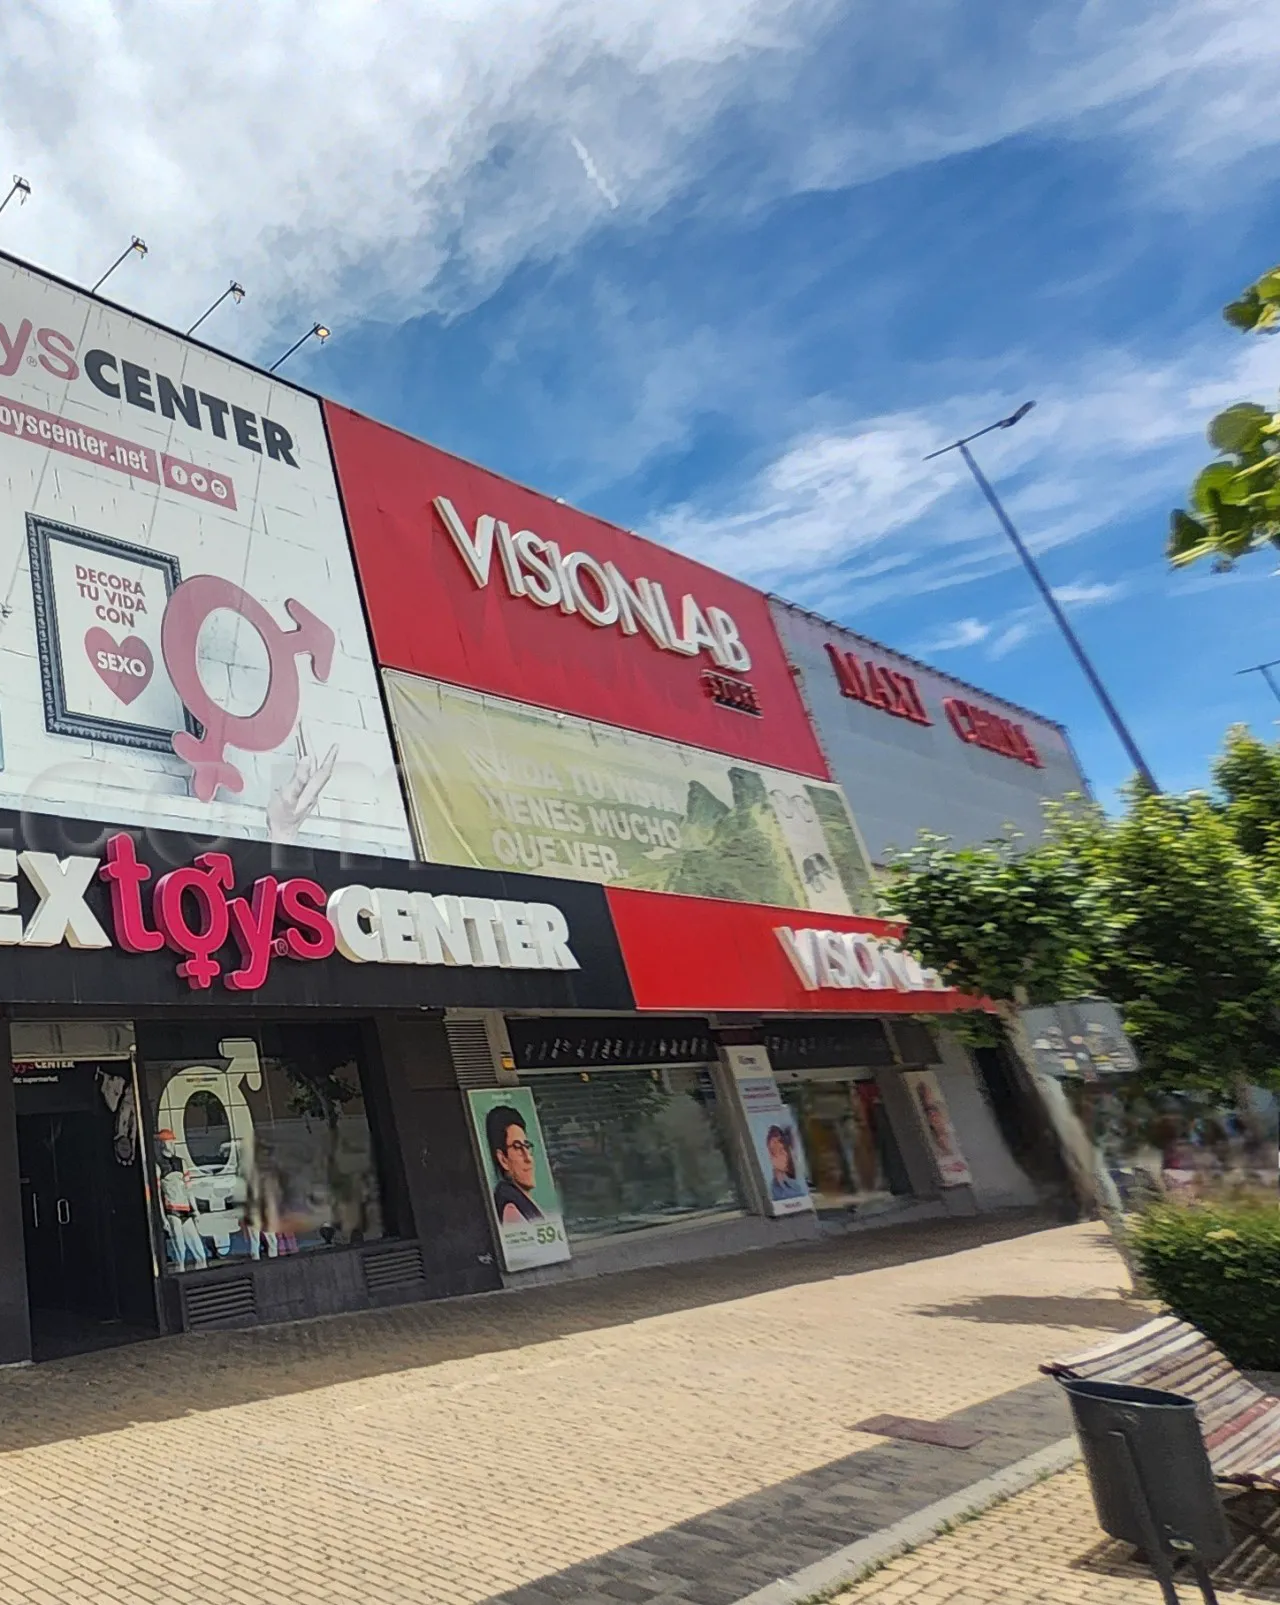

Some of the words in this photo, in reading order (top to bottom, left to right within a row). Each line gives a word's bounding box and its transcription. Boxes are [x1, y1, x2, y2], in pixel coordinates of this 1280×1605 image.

[75, 564, 146, 598] DECORA
[76, 581, 100, 601] TU
[104, 589, 148, 615] VIDA
[432, 495, 752, 673] VISIONLAB
[95, 604, 135, 628] CON
[96, 650, 147, 677] SEXO
[587, 805, 684, 850] MUCHO
[491, 828, 559, 868] QUE
